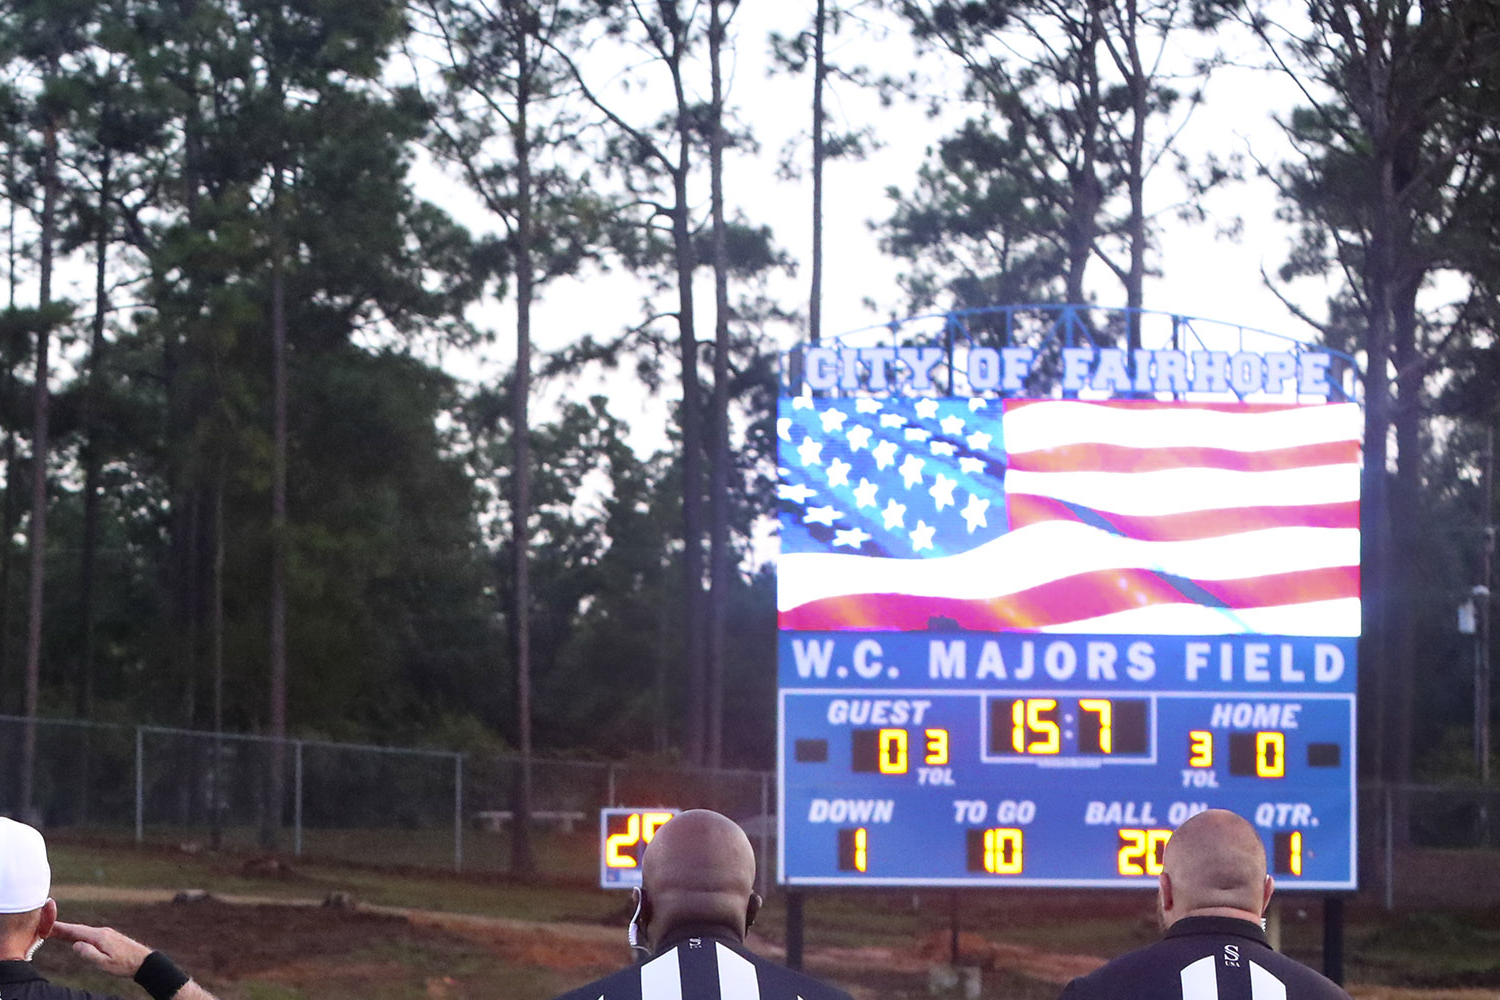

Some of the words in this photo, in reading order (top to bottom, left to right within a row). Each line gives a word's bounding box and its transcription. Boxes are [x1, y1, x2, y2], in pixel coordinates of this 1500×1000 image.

[804, 347, 944, 391] CITY
[967, 347, 1035, 391] OF
[1062, 348, 1331, 395] FAIRHOPE
[791, 638, 900, 679] W.C.
[928, 639, 1157, 682] MAJORS
[1184, 642, 1345, 683] FIELD
[826, 699, 932, 726] GUEST
[1209, 702, 1303, 729] HOME
[924, 728, 949, 766] 3
[1188, 730, 1213, 768] 3
[916, 767, 956, 787] TOL
[1180, 769, 1220, 789] TOL
[807, 798, 895, 825] DOWN
[952, 800, 988, 825] TO
[996, 800, 1037, 826] GO
[1084, 801, 1158, 827] BALL
[1254, 802, 1320, 828] QTR.
[854, 827, 868, 873] 1
[983, 827, 1023, 875] 10
[1289, 830, 1303, 876] 1
